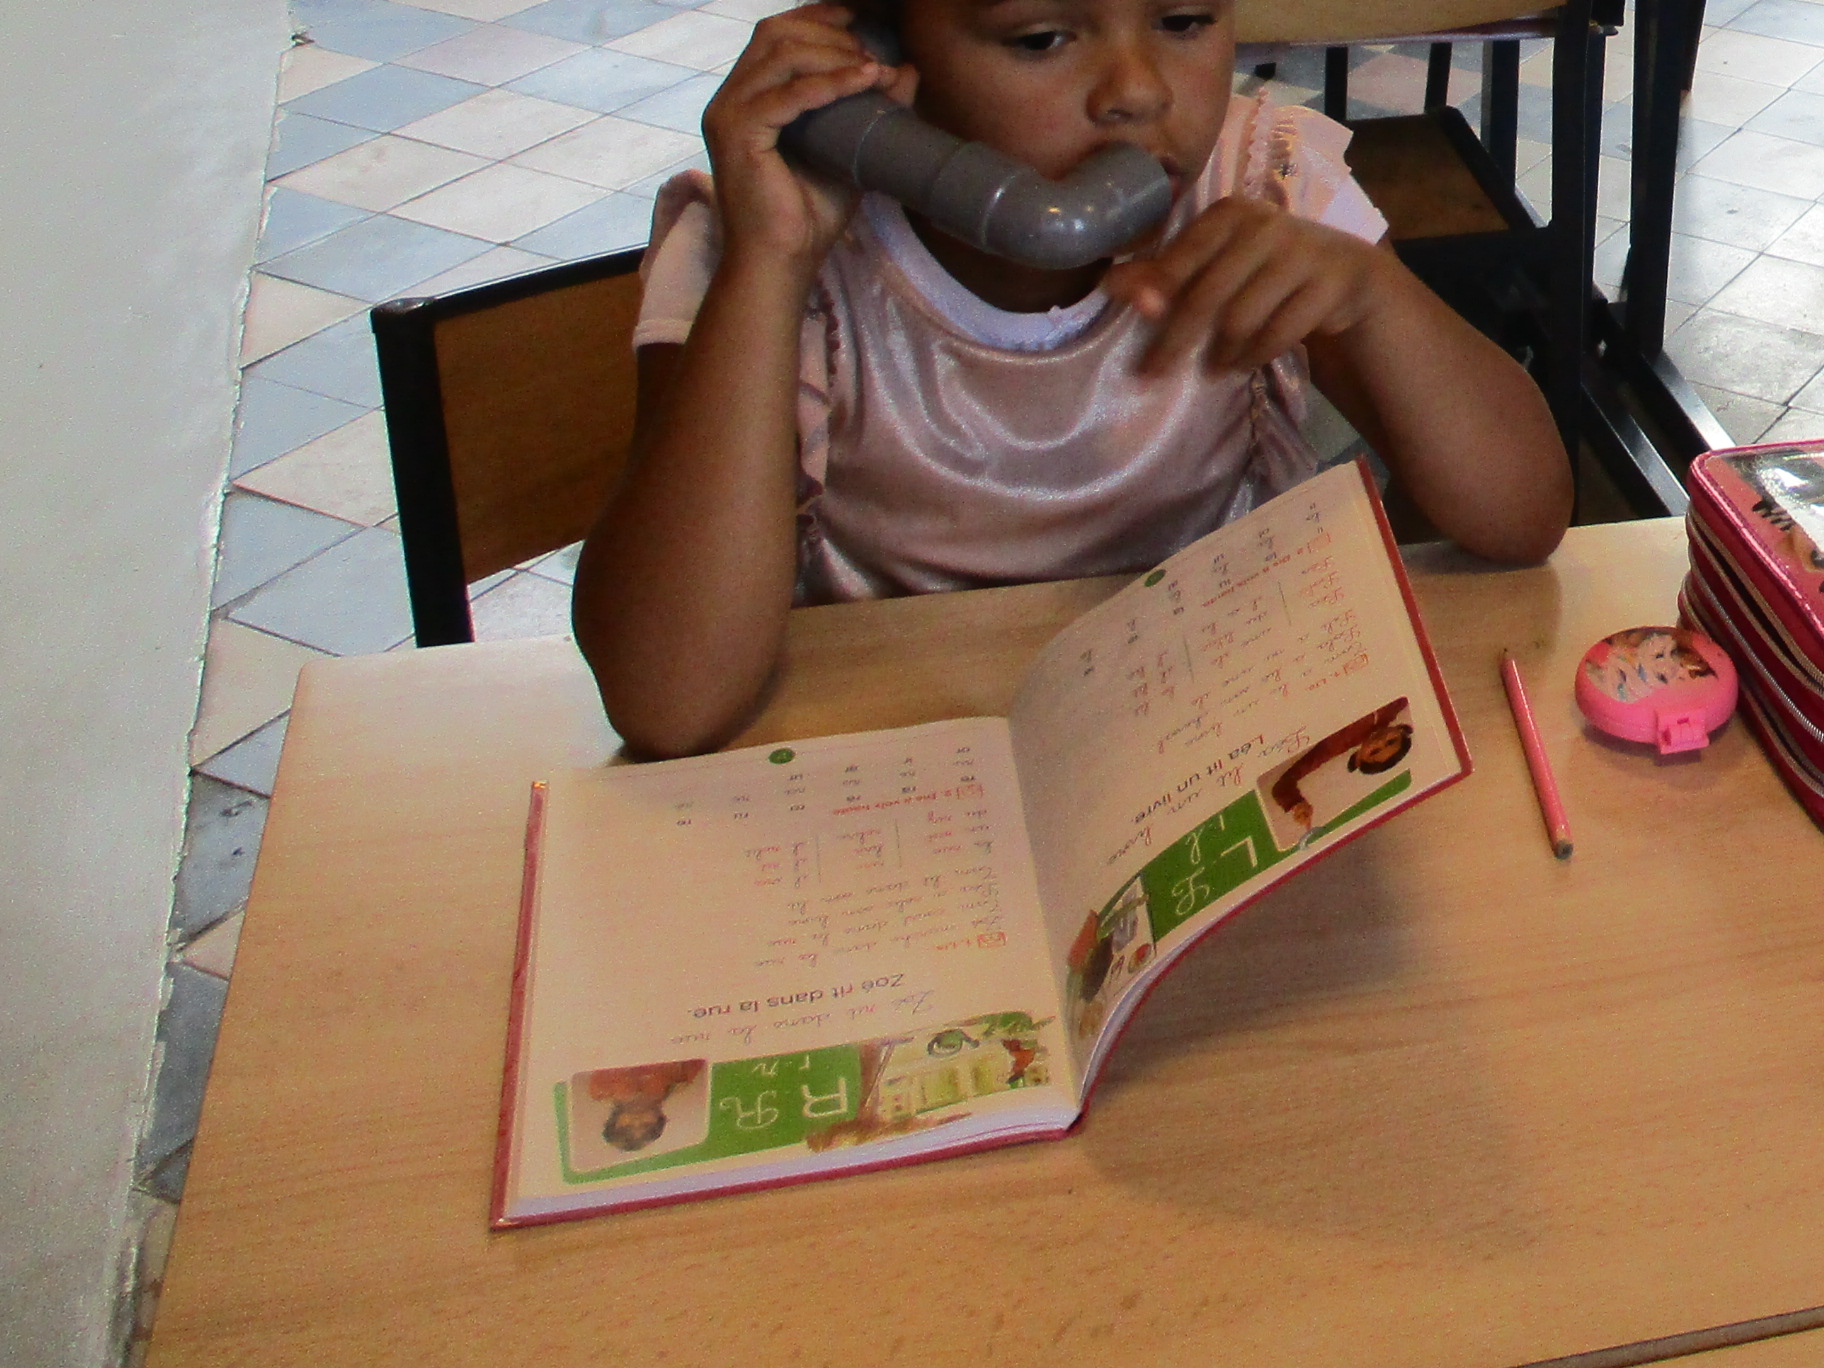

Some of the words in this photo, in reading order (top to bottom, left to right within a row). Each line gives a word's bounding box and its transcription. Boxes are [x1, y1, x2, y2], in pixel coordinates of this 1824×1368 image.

[1227, 734, 1264, 759] Léa
[1206, 759, 1222, 774] lit
[1177, 773, 1200, 791] un
[1131, 794, 1171, 823] livre.
[1220, 836, 1258, 868] L
[831, 982, 853, 999] rit
[860, 973, 905, 993] Zoé
[738, 999, 759, 1014] la
[765, 988, 824, 1009] dans
[686, 1003, 730, 1020] rue.
[799, 1075, 848, 1118] R
[719, 1089, 779, 1130] R
